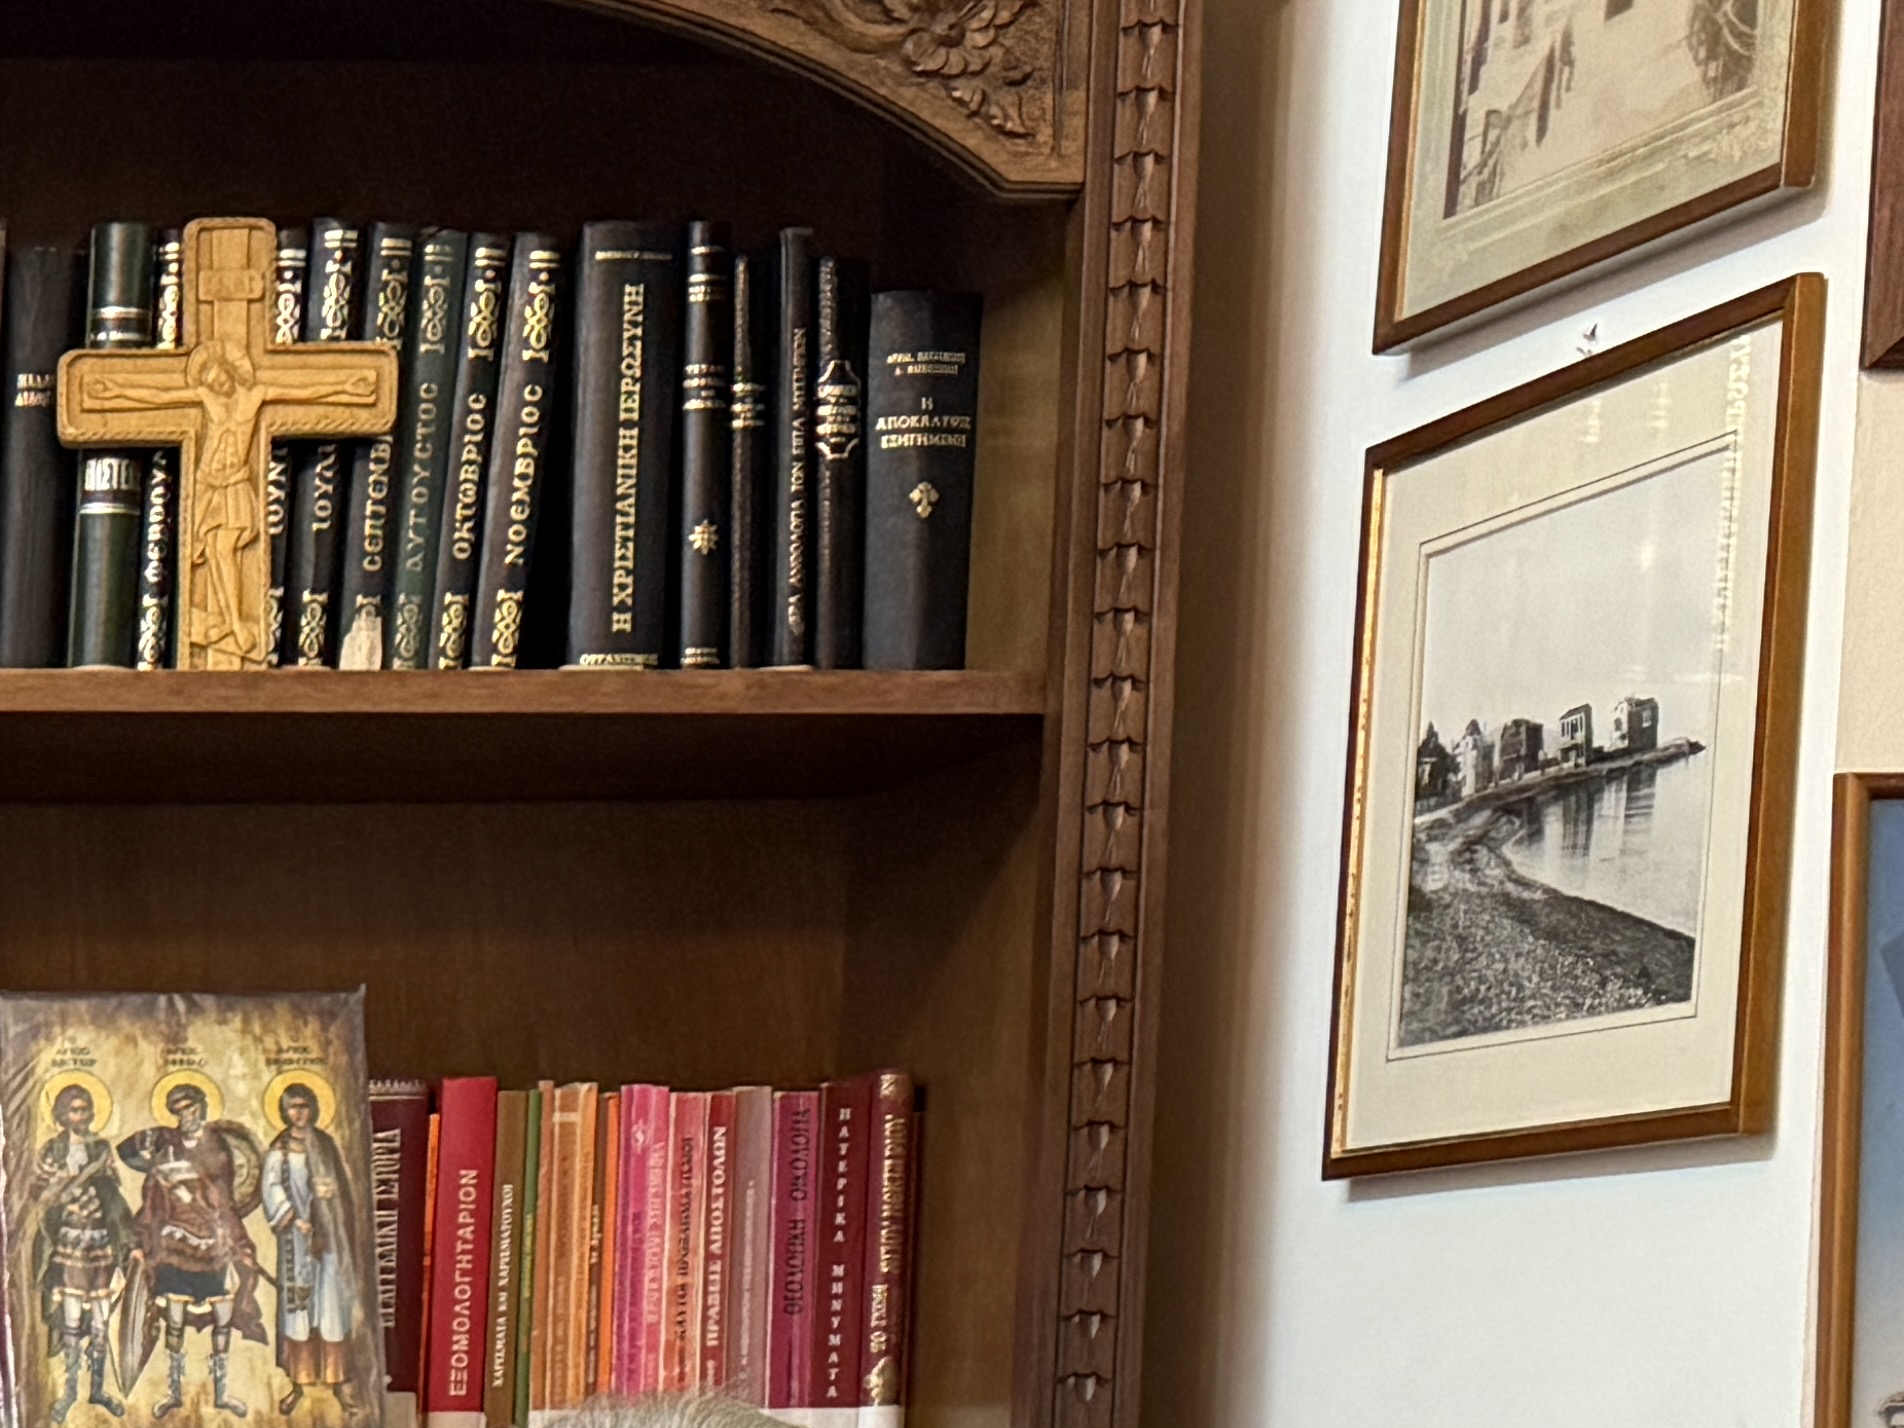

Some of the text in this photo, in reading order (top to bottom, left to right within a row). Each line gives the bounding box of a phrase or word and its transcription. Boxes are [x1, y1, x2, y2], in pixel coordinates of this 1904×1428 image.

[611, 284, 644, 632] Η ΧΡΙΣΤΙΑΝΙΚΗ ΙΕΡΩΣΥΝΗ
[450, 1169, 477, 1396] ΕΞΟΜΟΛΟΓΗΤΑΡΙΟΝ
[706, 1126, 727, 1347] ΠΡΑΞΕΙΣ ΑΠΟΣΤΟΛΩΝ
